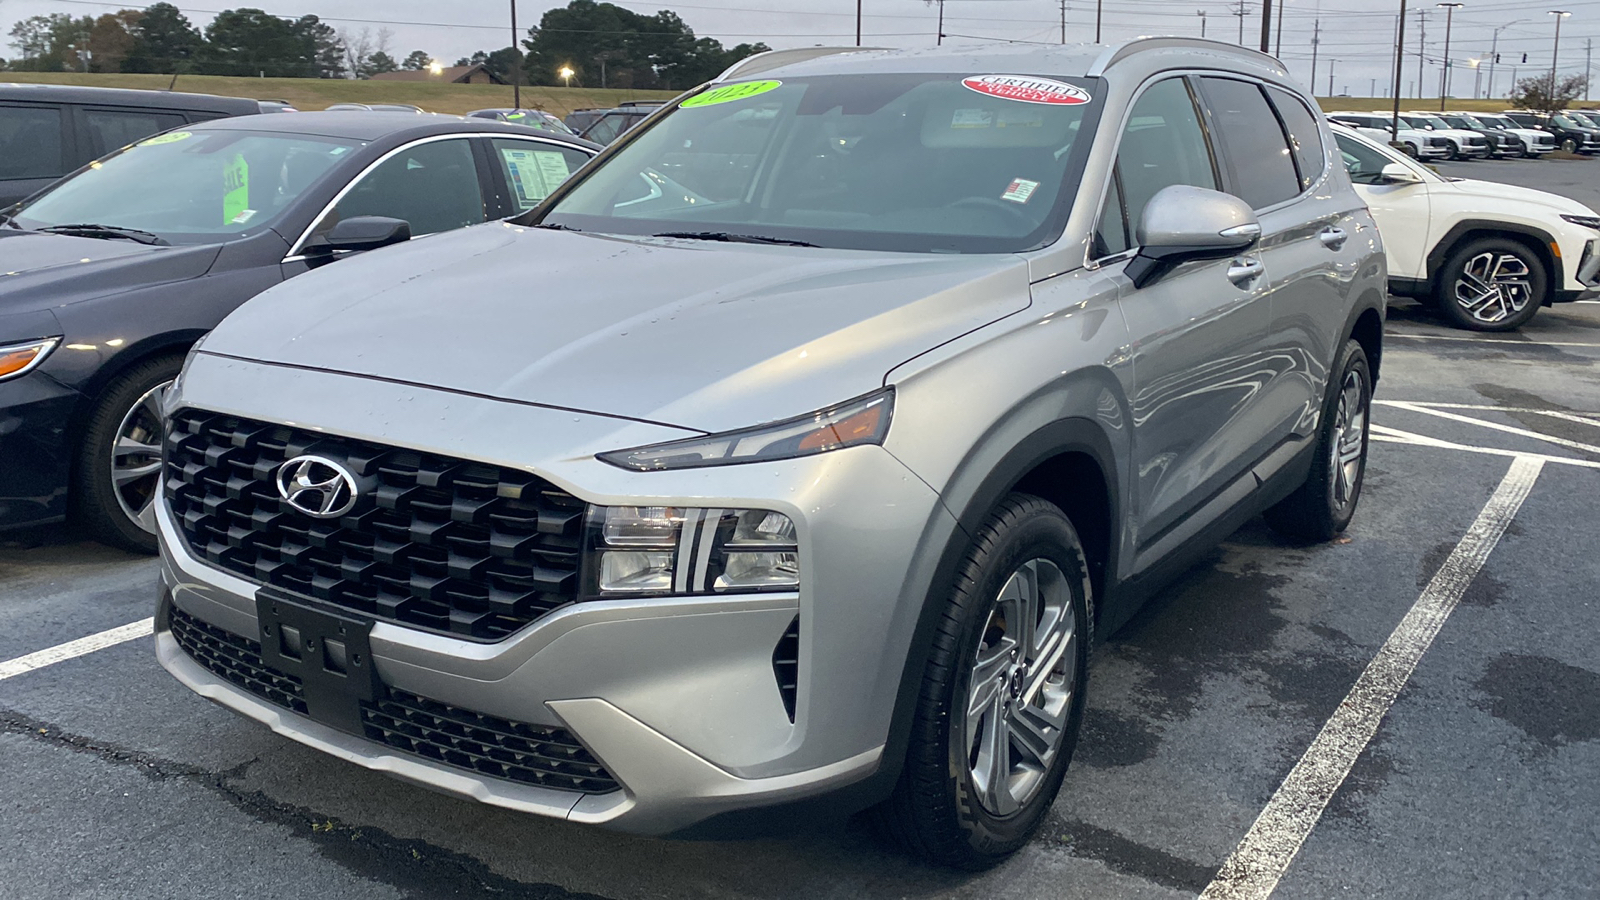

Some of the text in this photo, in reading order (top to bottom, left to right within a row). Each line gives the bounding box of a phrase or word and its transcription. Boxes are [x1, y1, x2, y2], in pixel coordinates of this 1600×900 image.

[978, 81, 1067, 100] PRE-OWNED
[981, 76, 1079, 96] CERTIFIED
[988, 86, 1048, 101] VEHICLE
